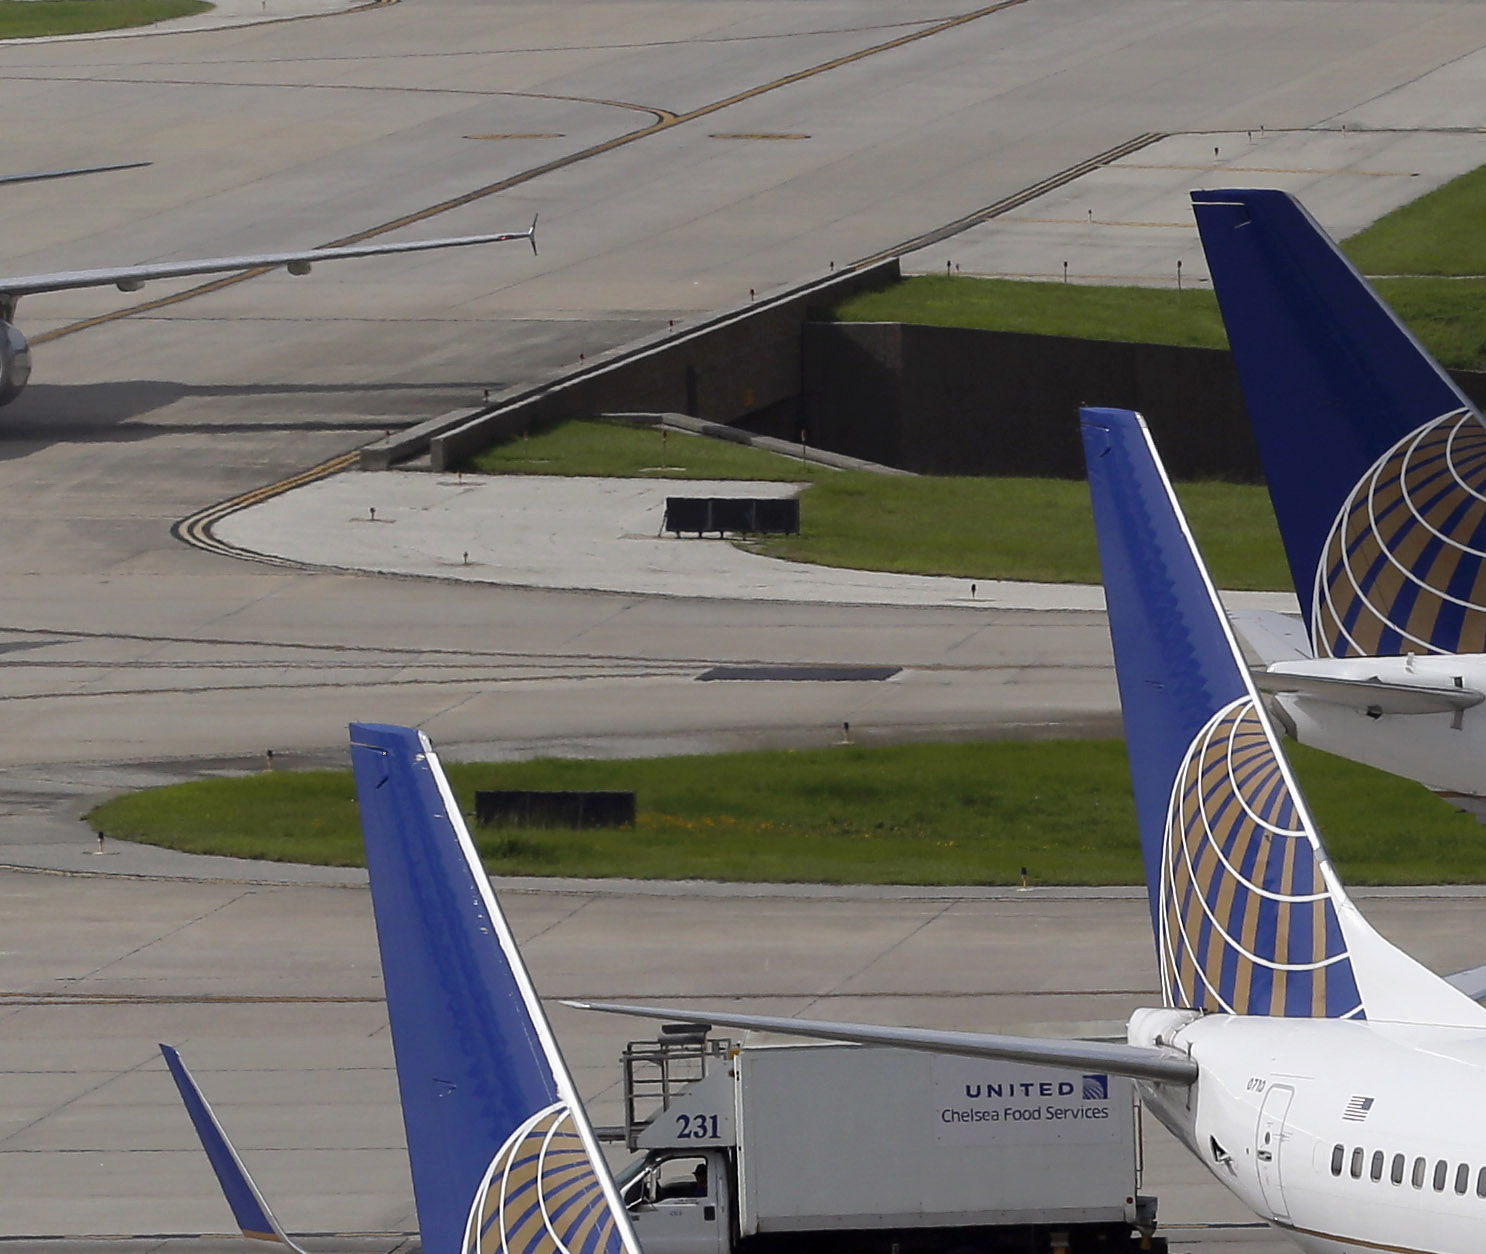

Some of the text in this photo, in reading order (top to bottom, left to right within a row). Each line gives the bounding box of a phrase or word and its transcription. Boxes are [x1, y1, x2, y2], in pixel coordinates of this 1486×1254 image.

[965, 1082, 1074, 1098] UNITED
[1246, 1077, 1266, 1092] 0710
[941, 1104, 1109, 1122] Chelsea Food Services
[675, 1114, 722, 1140] 231
